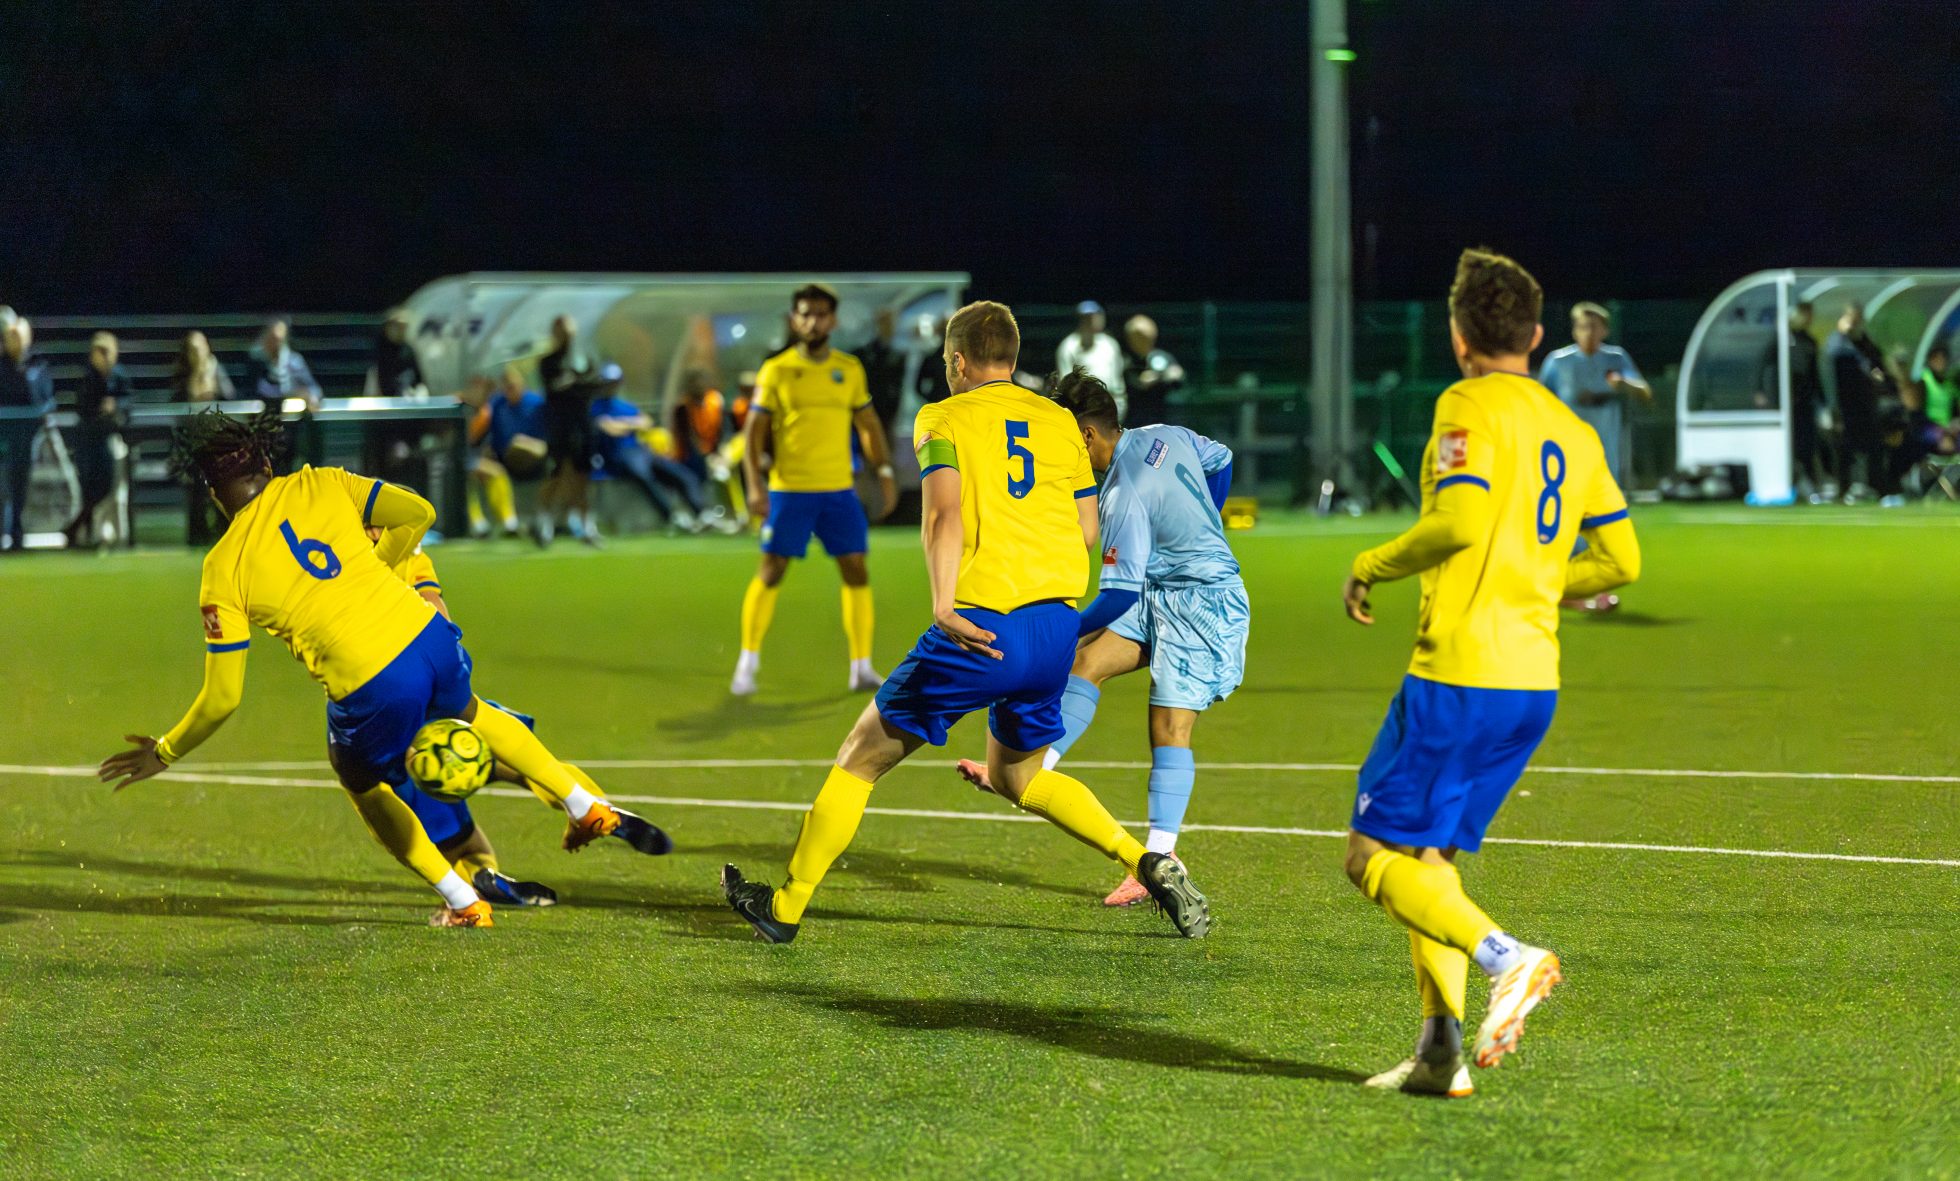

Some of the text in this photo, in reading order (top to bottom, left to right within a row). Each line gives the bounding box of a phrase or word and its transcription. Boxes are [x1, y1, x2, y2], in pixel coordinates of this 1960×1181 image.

[1005, 419, 1035, 499] 5
[1537, 440, 1566, 545] 8
[278, 518, 342, 580] 6
